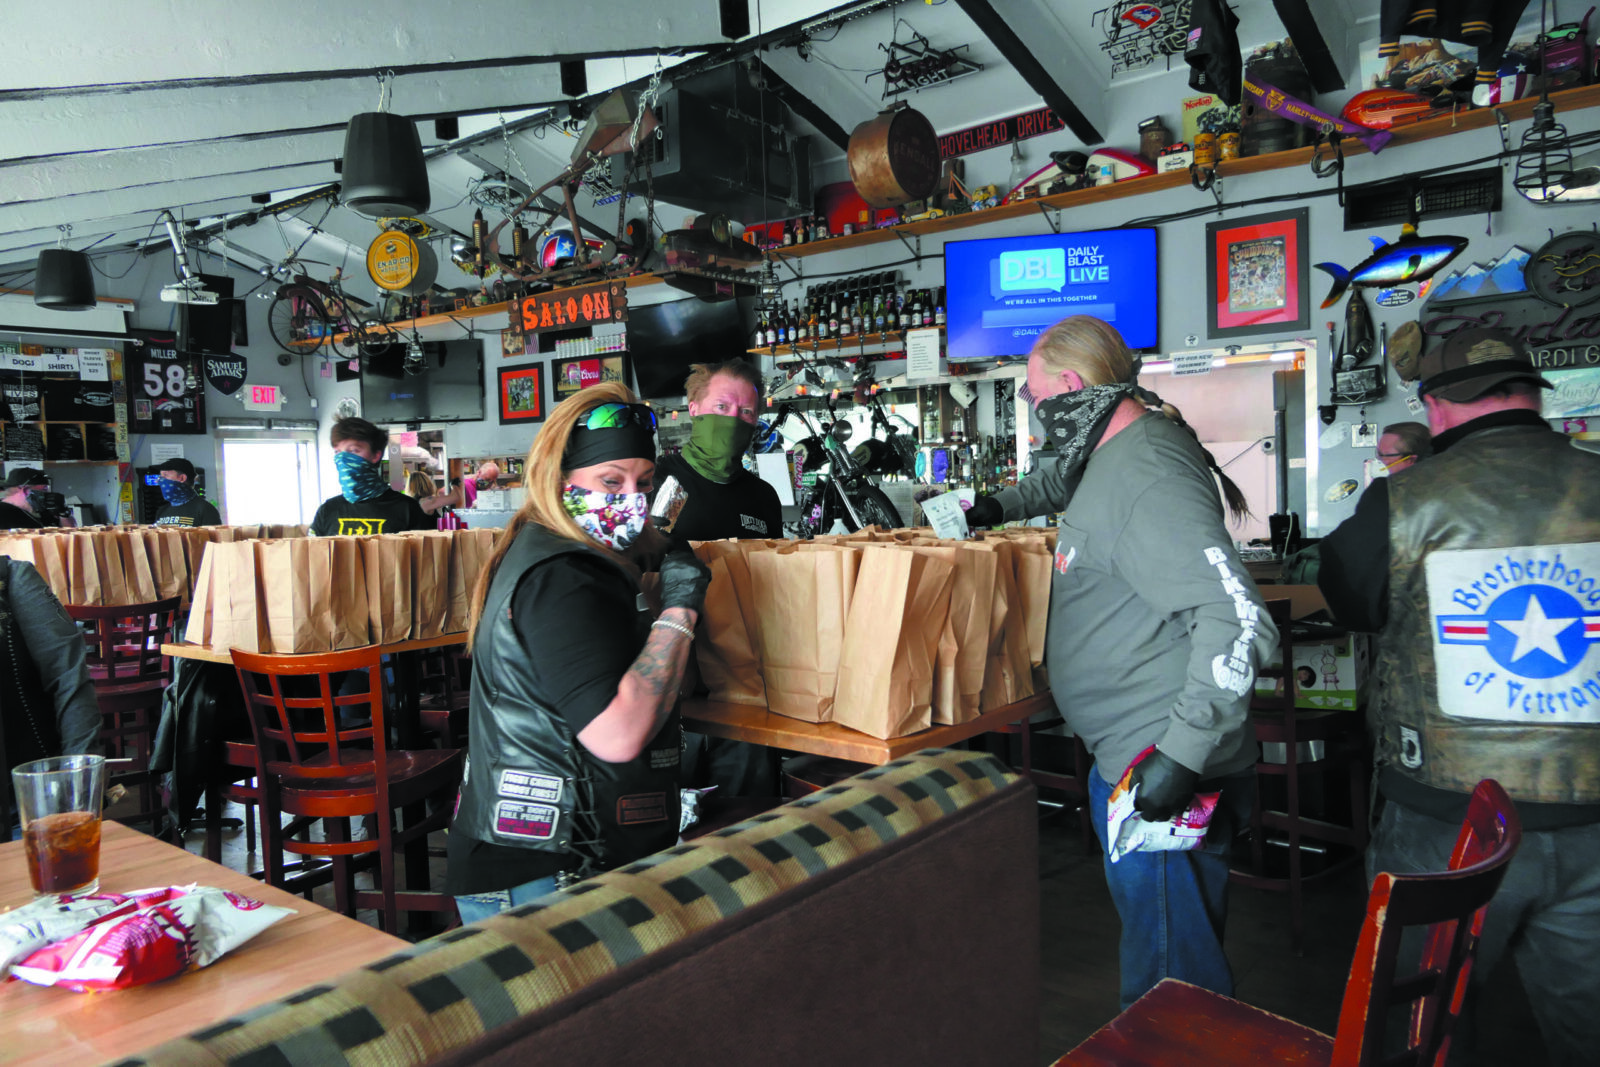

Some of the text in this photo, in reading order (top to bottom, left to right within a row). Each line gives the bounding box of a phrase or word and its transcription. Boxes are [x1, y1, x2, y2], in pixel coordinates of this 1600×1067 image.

[1017, 109, 1054, 138] DRIVE
[1068, 246, 1099, 257] DAILY
[1004, 255, 1062, 282] DBL
[1068, 255, 1105, 267] BLAST
[1070, 266, 1109, 282] LIVE
[522, 291, 611, 331] SALOON
[151, 348, 177, 359] MILLER
[12, 358, 35, 366] DOGS
[207, 359, 246, 371] SAMUEL
[143, 362, 185, 398] 58
[211, 368, 243, 378] ADAMS
[252, 386, 276, 404] EXIT
[1464, 671, 1496, 694] of
